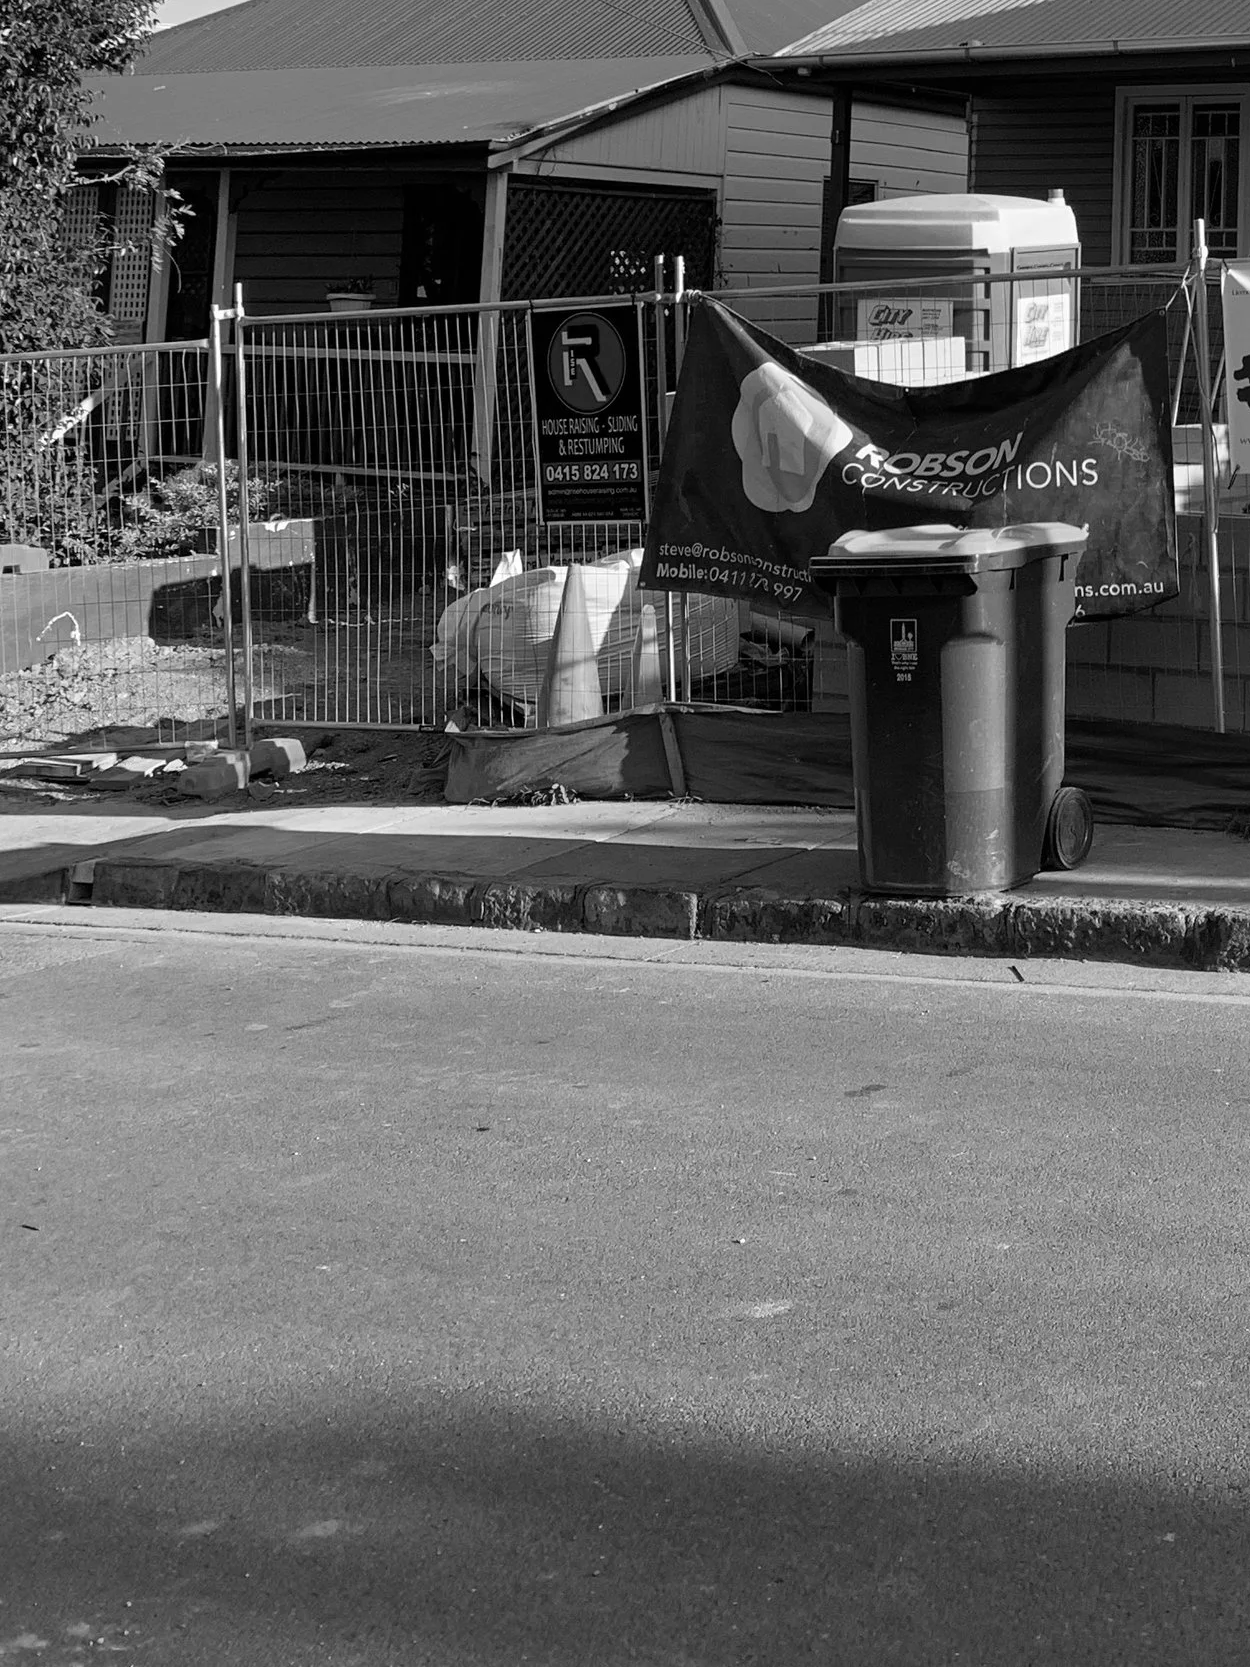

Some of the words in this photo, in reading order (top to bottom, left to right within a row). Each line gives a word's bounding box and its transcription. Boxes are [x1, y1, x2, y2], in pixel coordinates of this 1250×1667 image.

[542, 418, 567, 435] HOUSE
[568, 417, 600, 435] RAISING
[607, 415, 638, 433] SLIDING
[558, 439, 567, 456] &
[567, 437, 625, 455] RESTUMPING
[855, 432, 1024, 477] ROBSON
[546, 465, 579, 482] 0415
[583, 463, 609, 481] 824
[612, 463, 638, 480] 173
[842, 458, 1099, 498] CONSTRUCTIONS
[773, 582, 803, 602] 997
